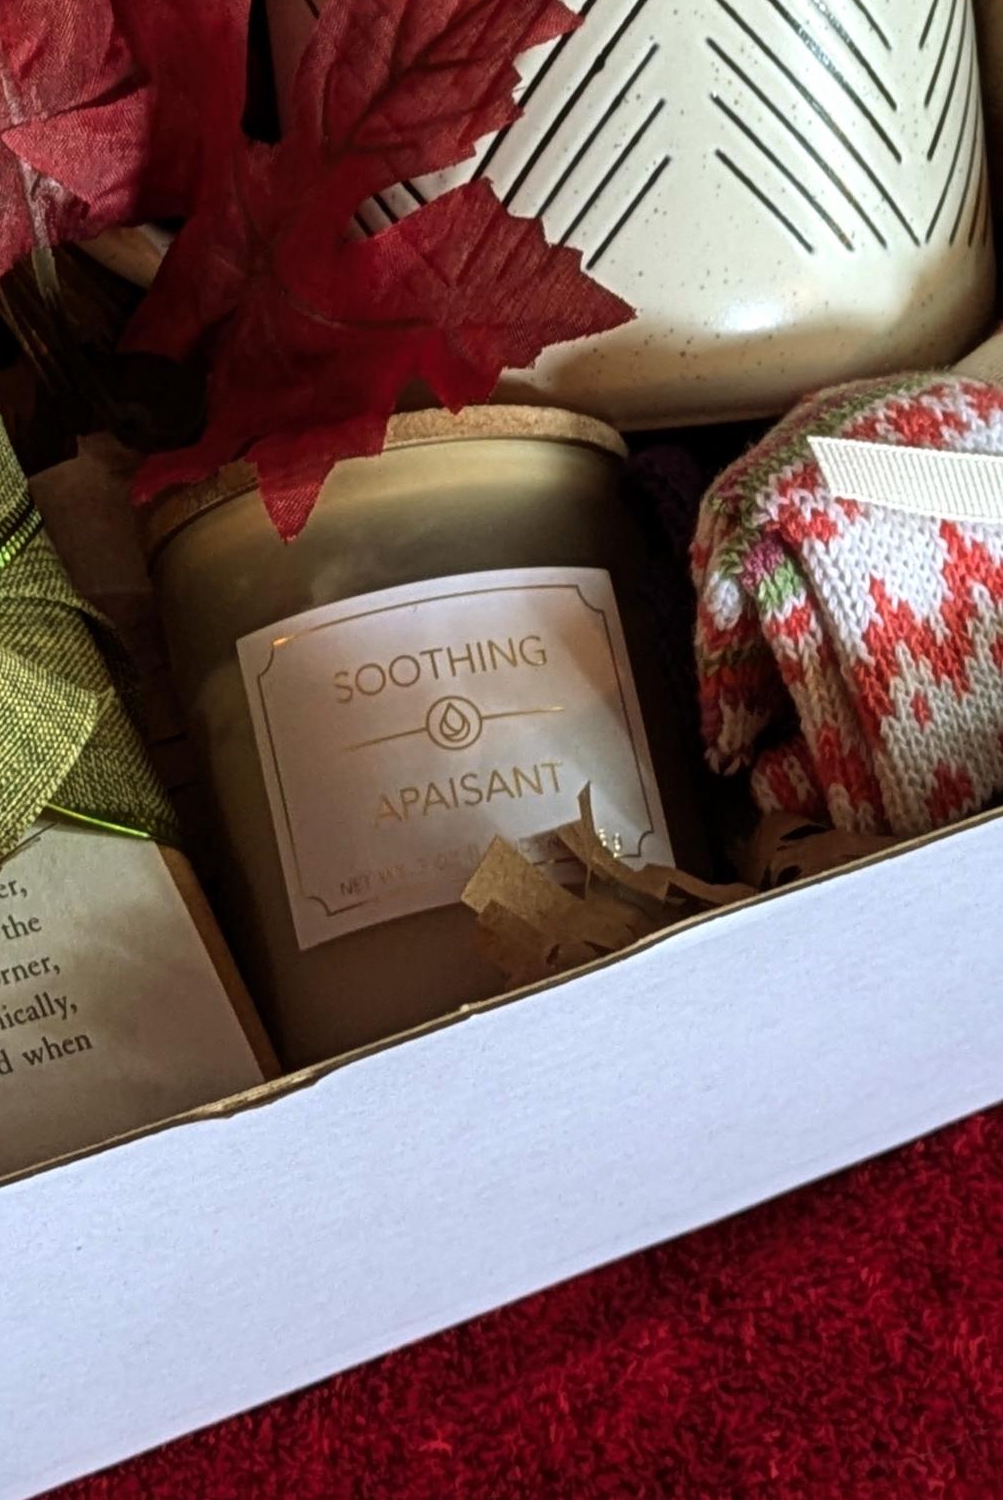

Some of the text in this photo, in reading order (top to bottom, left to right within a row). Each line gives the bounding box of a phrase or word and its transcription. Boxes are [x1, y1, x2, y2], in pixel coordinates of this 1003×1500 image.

[333, 634, 548, 703] SOOTHING
[373, 761, 564, 828] APAISANT
[1, 913, 43, 941] the
[22, 1033, 94, 1067] when
